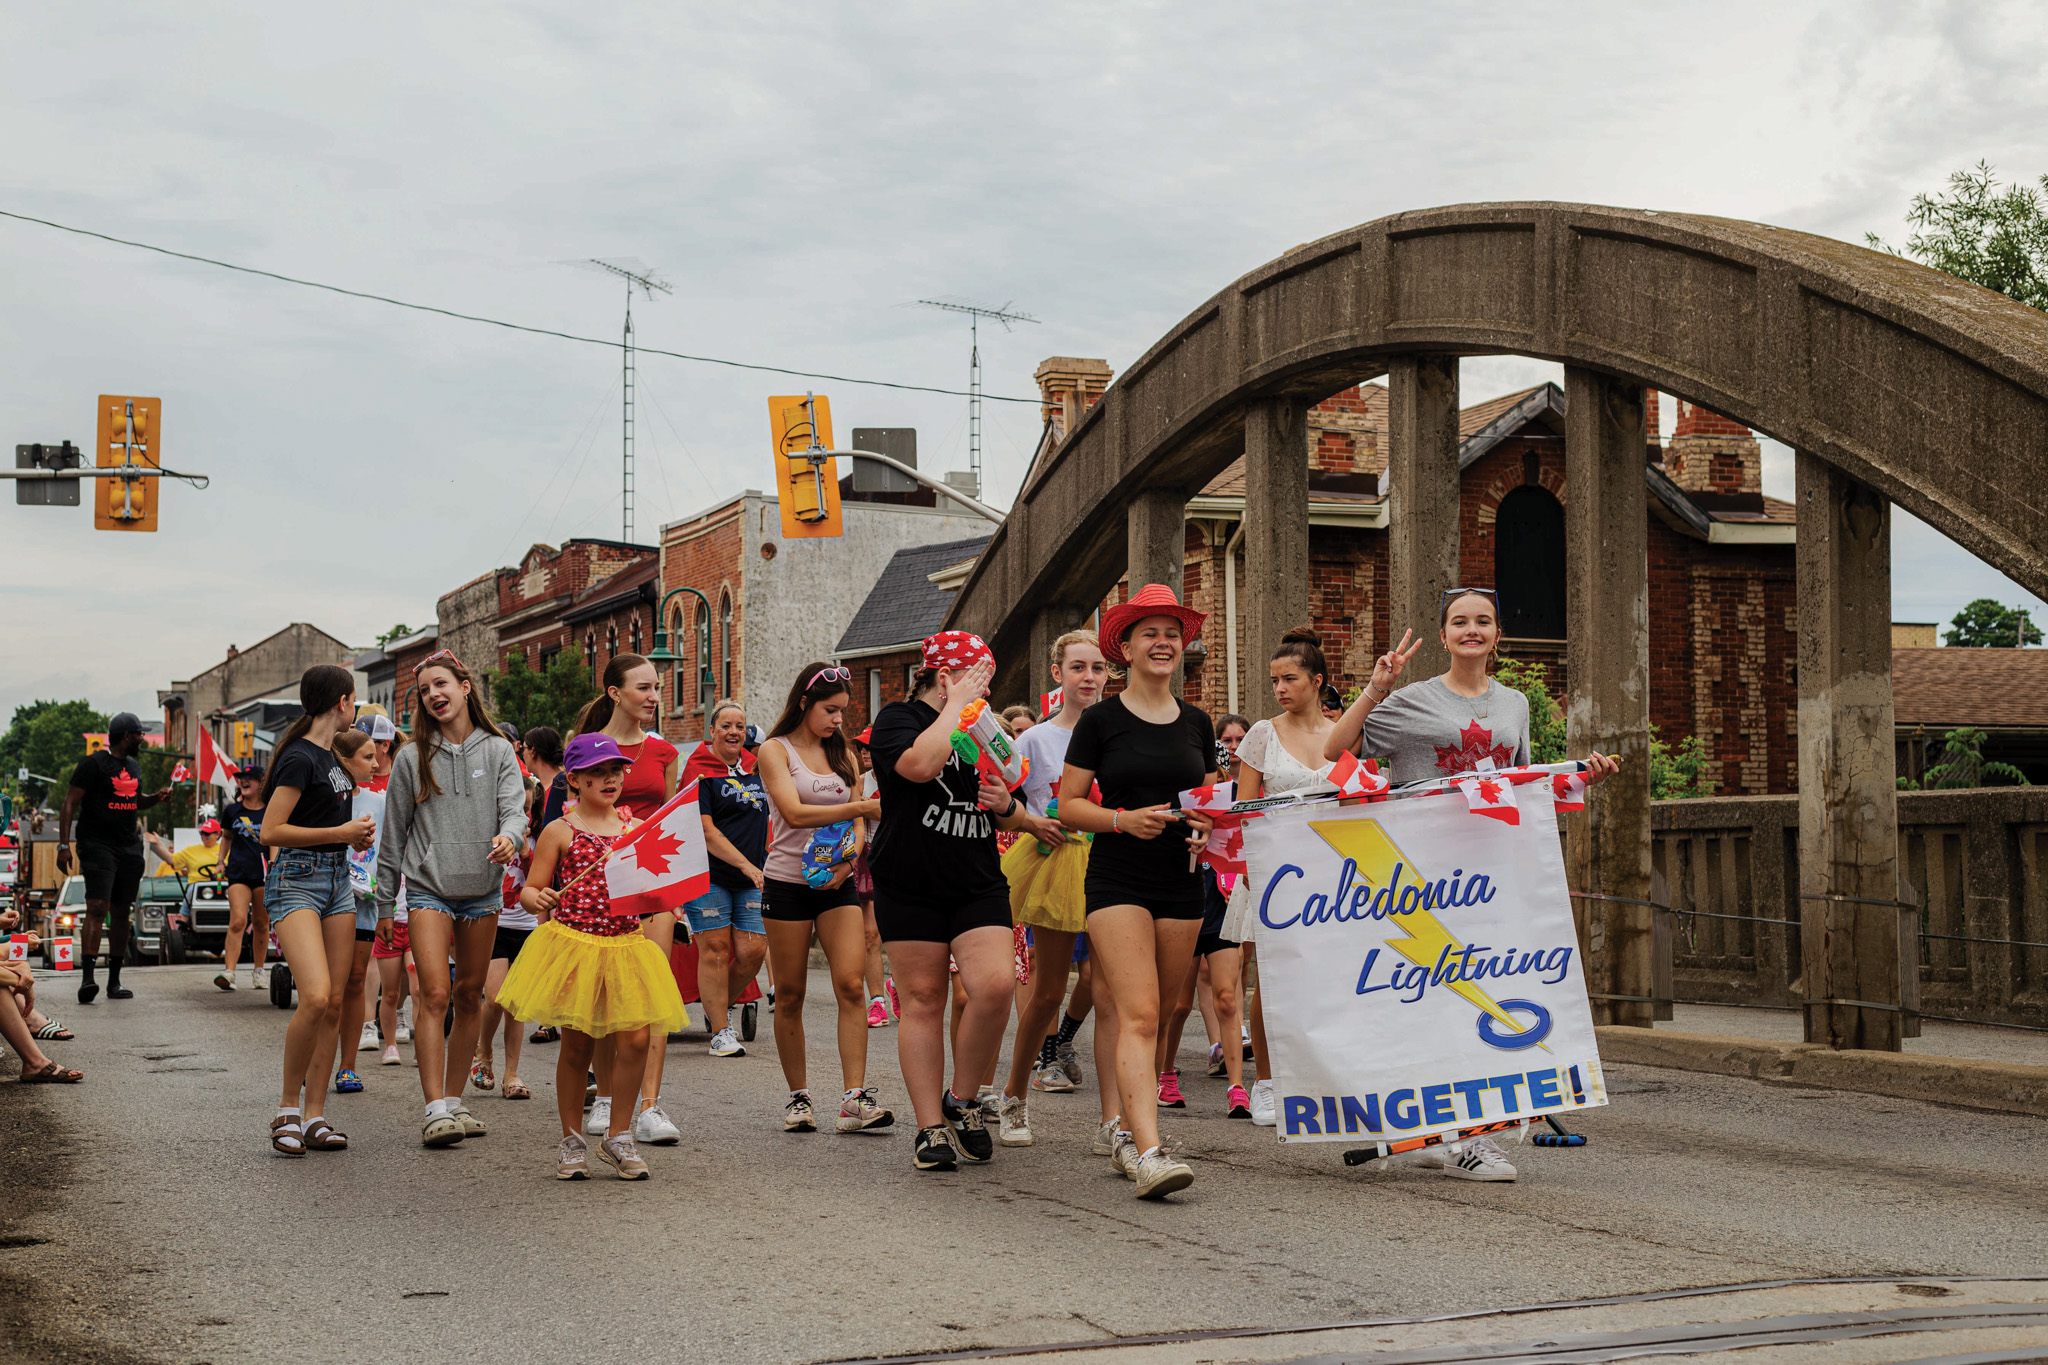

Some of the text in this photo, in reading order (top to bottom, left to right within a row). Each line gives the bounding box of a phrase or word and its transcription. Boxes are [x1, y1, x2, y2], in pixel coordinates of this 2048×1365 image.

[812, 779, 840, 793] Canada
[1259, 857, 1496, 929] Caledonia
[1355, 943, 1573, 1004] Lightning
[1283, 1064, 1586, 1137] RINGETTE!
